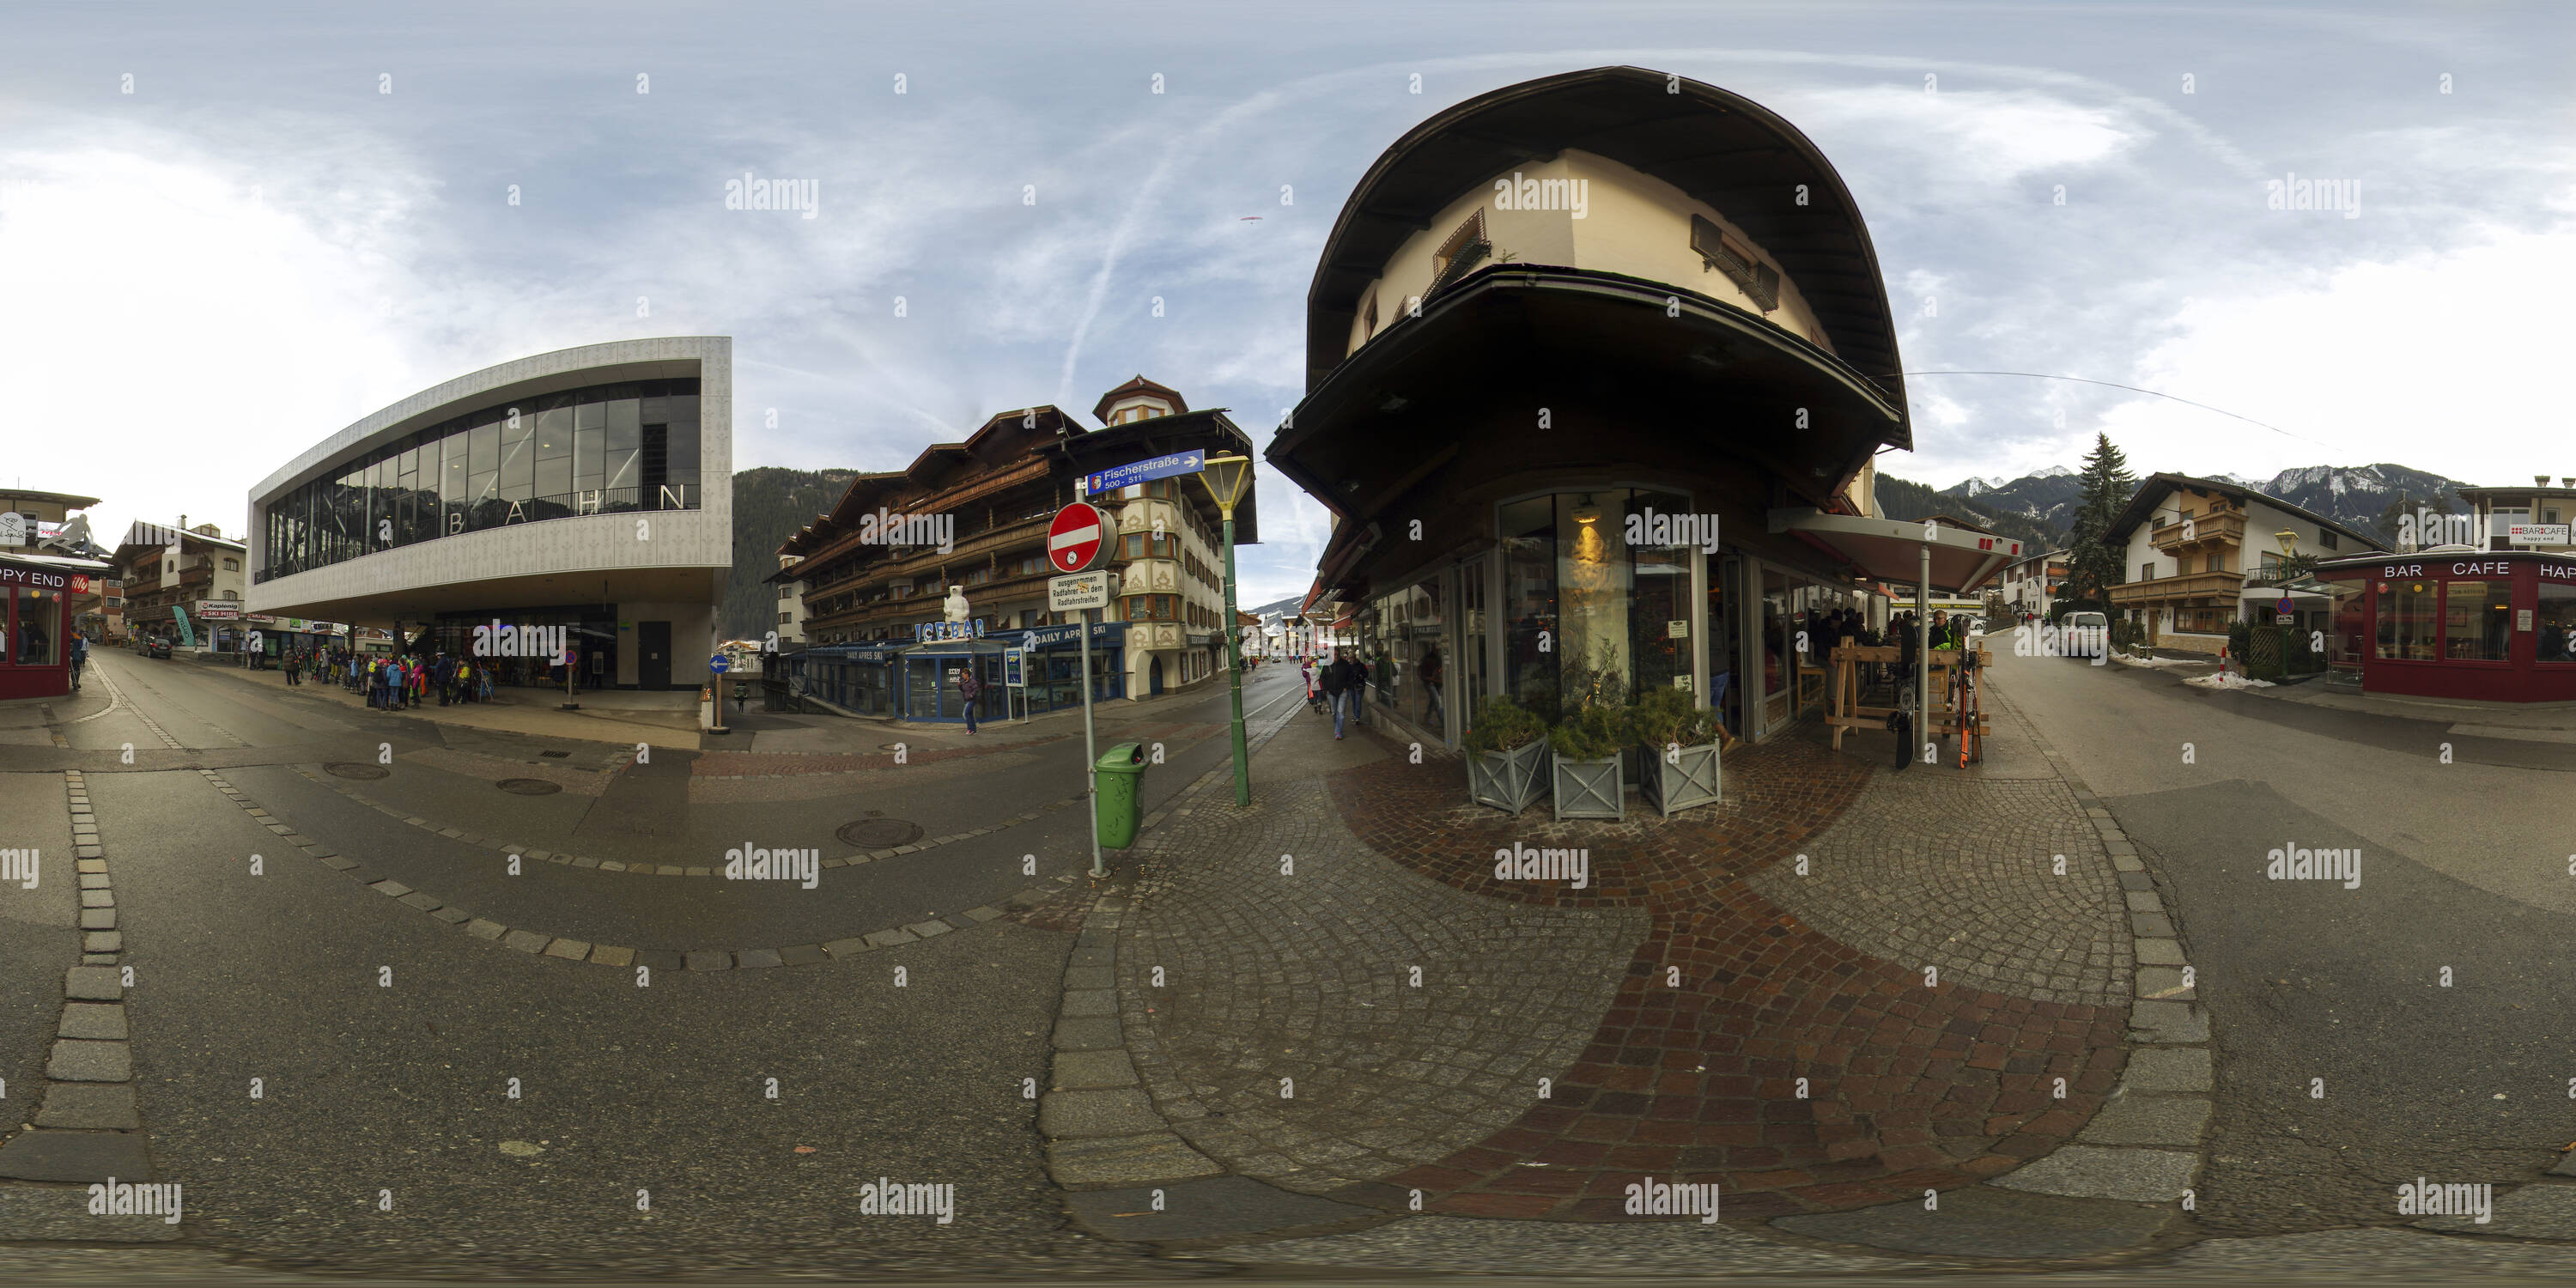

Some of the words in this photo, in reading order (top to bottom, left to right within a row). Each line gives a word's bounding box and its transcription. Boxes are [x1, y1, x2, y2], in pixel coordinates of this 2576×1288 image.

[1104, 457, 1179, 480] Fischerstraße
[1104, 480, 1121, 489] 500
[1127, 475, 1142, 483] 511
[2385, 564, 2423, 578] BAR
[2452, 562, 2510, 575] CAFE
[32, 573, 64, 587] END
[71, 576, 88, 592] illy
[1058, 576, 1097, 587] ausgenommen
[1053, 587, 1078, 597] Radfahrer
[1057, 596, 1099, 606] Radfahrstreifen
[914, 621, 945, 643] ICE
[951, 618, 984, 639] BAR
[1035, 632, 1060, 645] DAILY
[1065, 629, 1081, 640] APR
[1092, 625, 1106, 635] SKI
[873, 652, 883, 660] SKI
